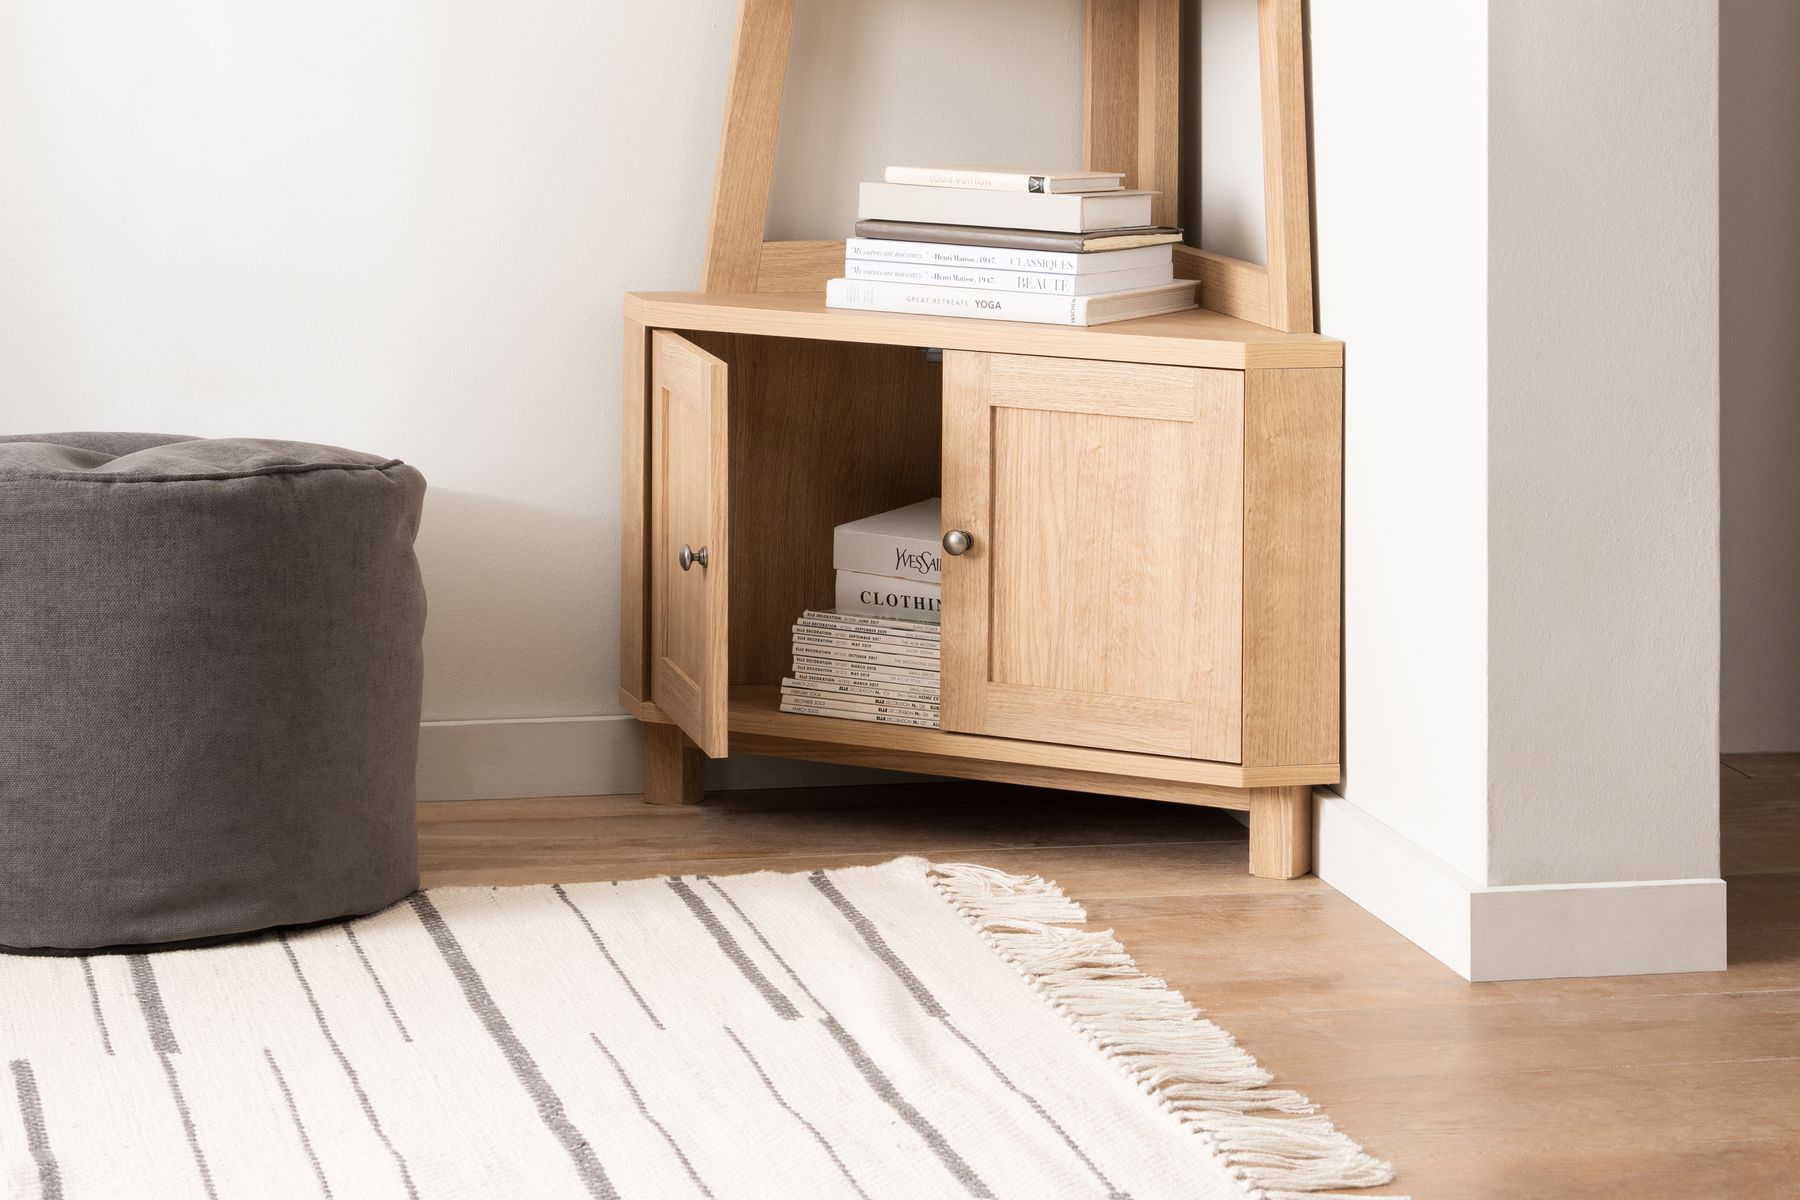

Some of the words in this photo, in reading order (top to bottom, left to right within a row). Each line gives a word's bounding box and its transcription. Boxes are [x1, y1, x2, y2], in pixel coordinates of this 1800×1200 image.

[929, 176, 953, 184] LOUIS
[954, 176, 992, 186] VUITTON
[1010, 257, 1073, 271] CLASSIQUES
[906, 295, 929, 303] GREAT
[932, 297, 969, 306] RETREATS
[974, 299, 1002, 310] YOGA
